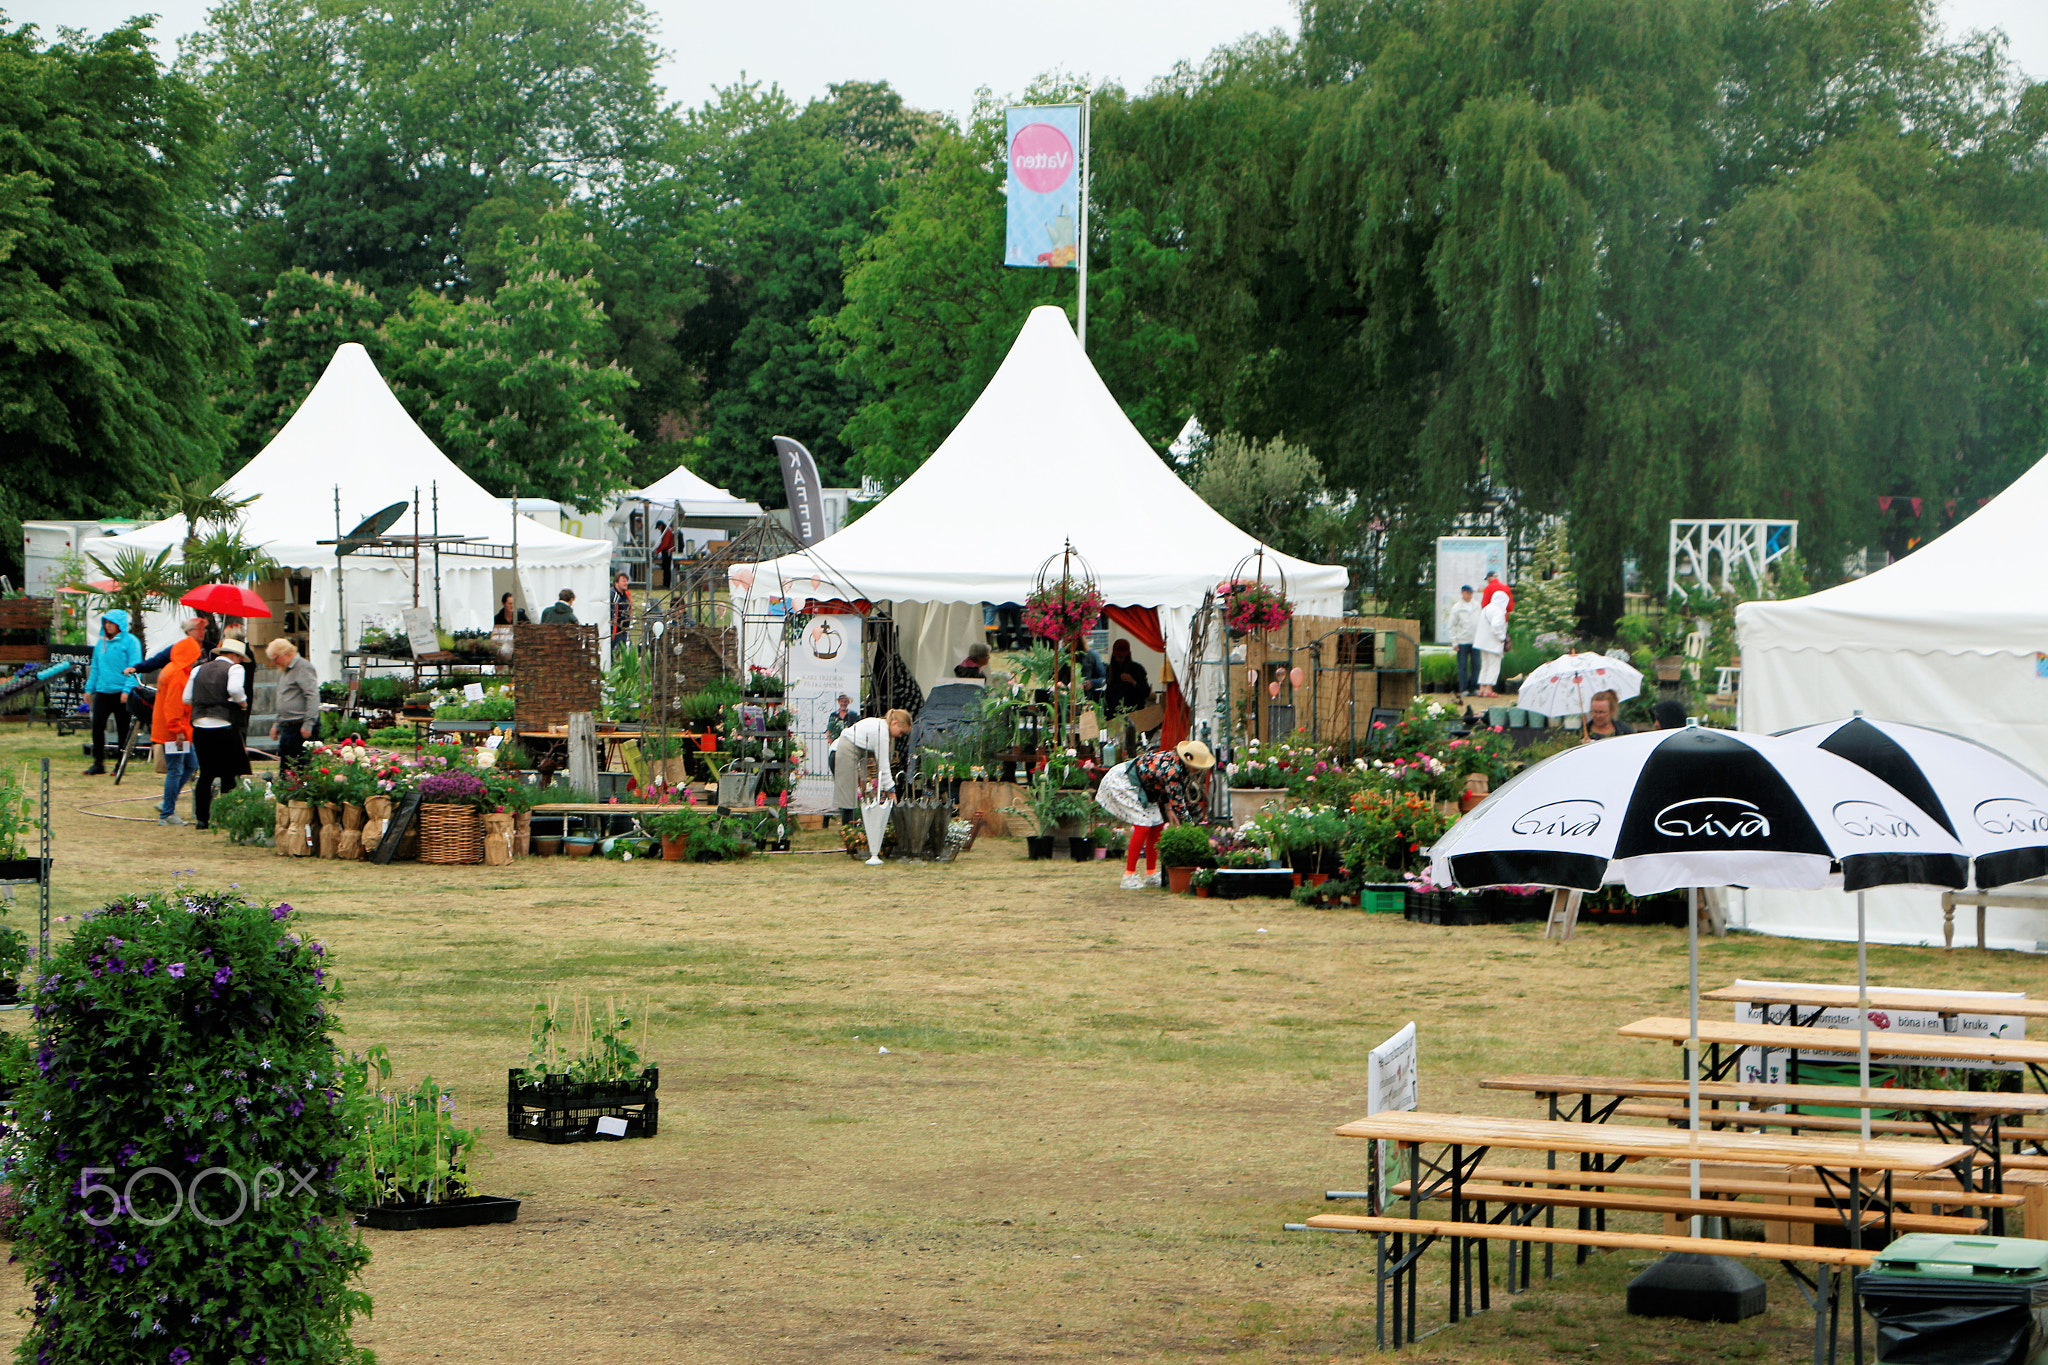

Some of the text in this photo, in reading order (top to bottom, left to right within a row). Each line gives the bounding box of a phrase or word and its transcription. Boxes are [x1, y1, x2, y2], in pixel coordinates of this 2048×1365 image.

[1898, 1016, 1921, 1028] böna
[1927, 1020, 1939, 1029] en
[1963, 1018, 1989, 1030] kruka
